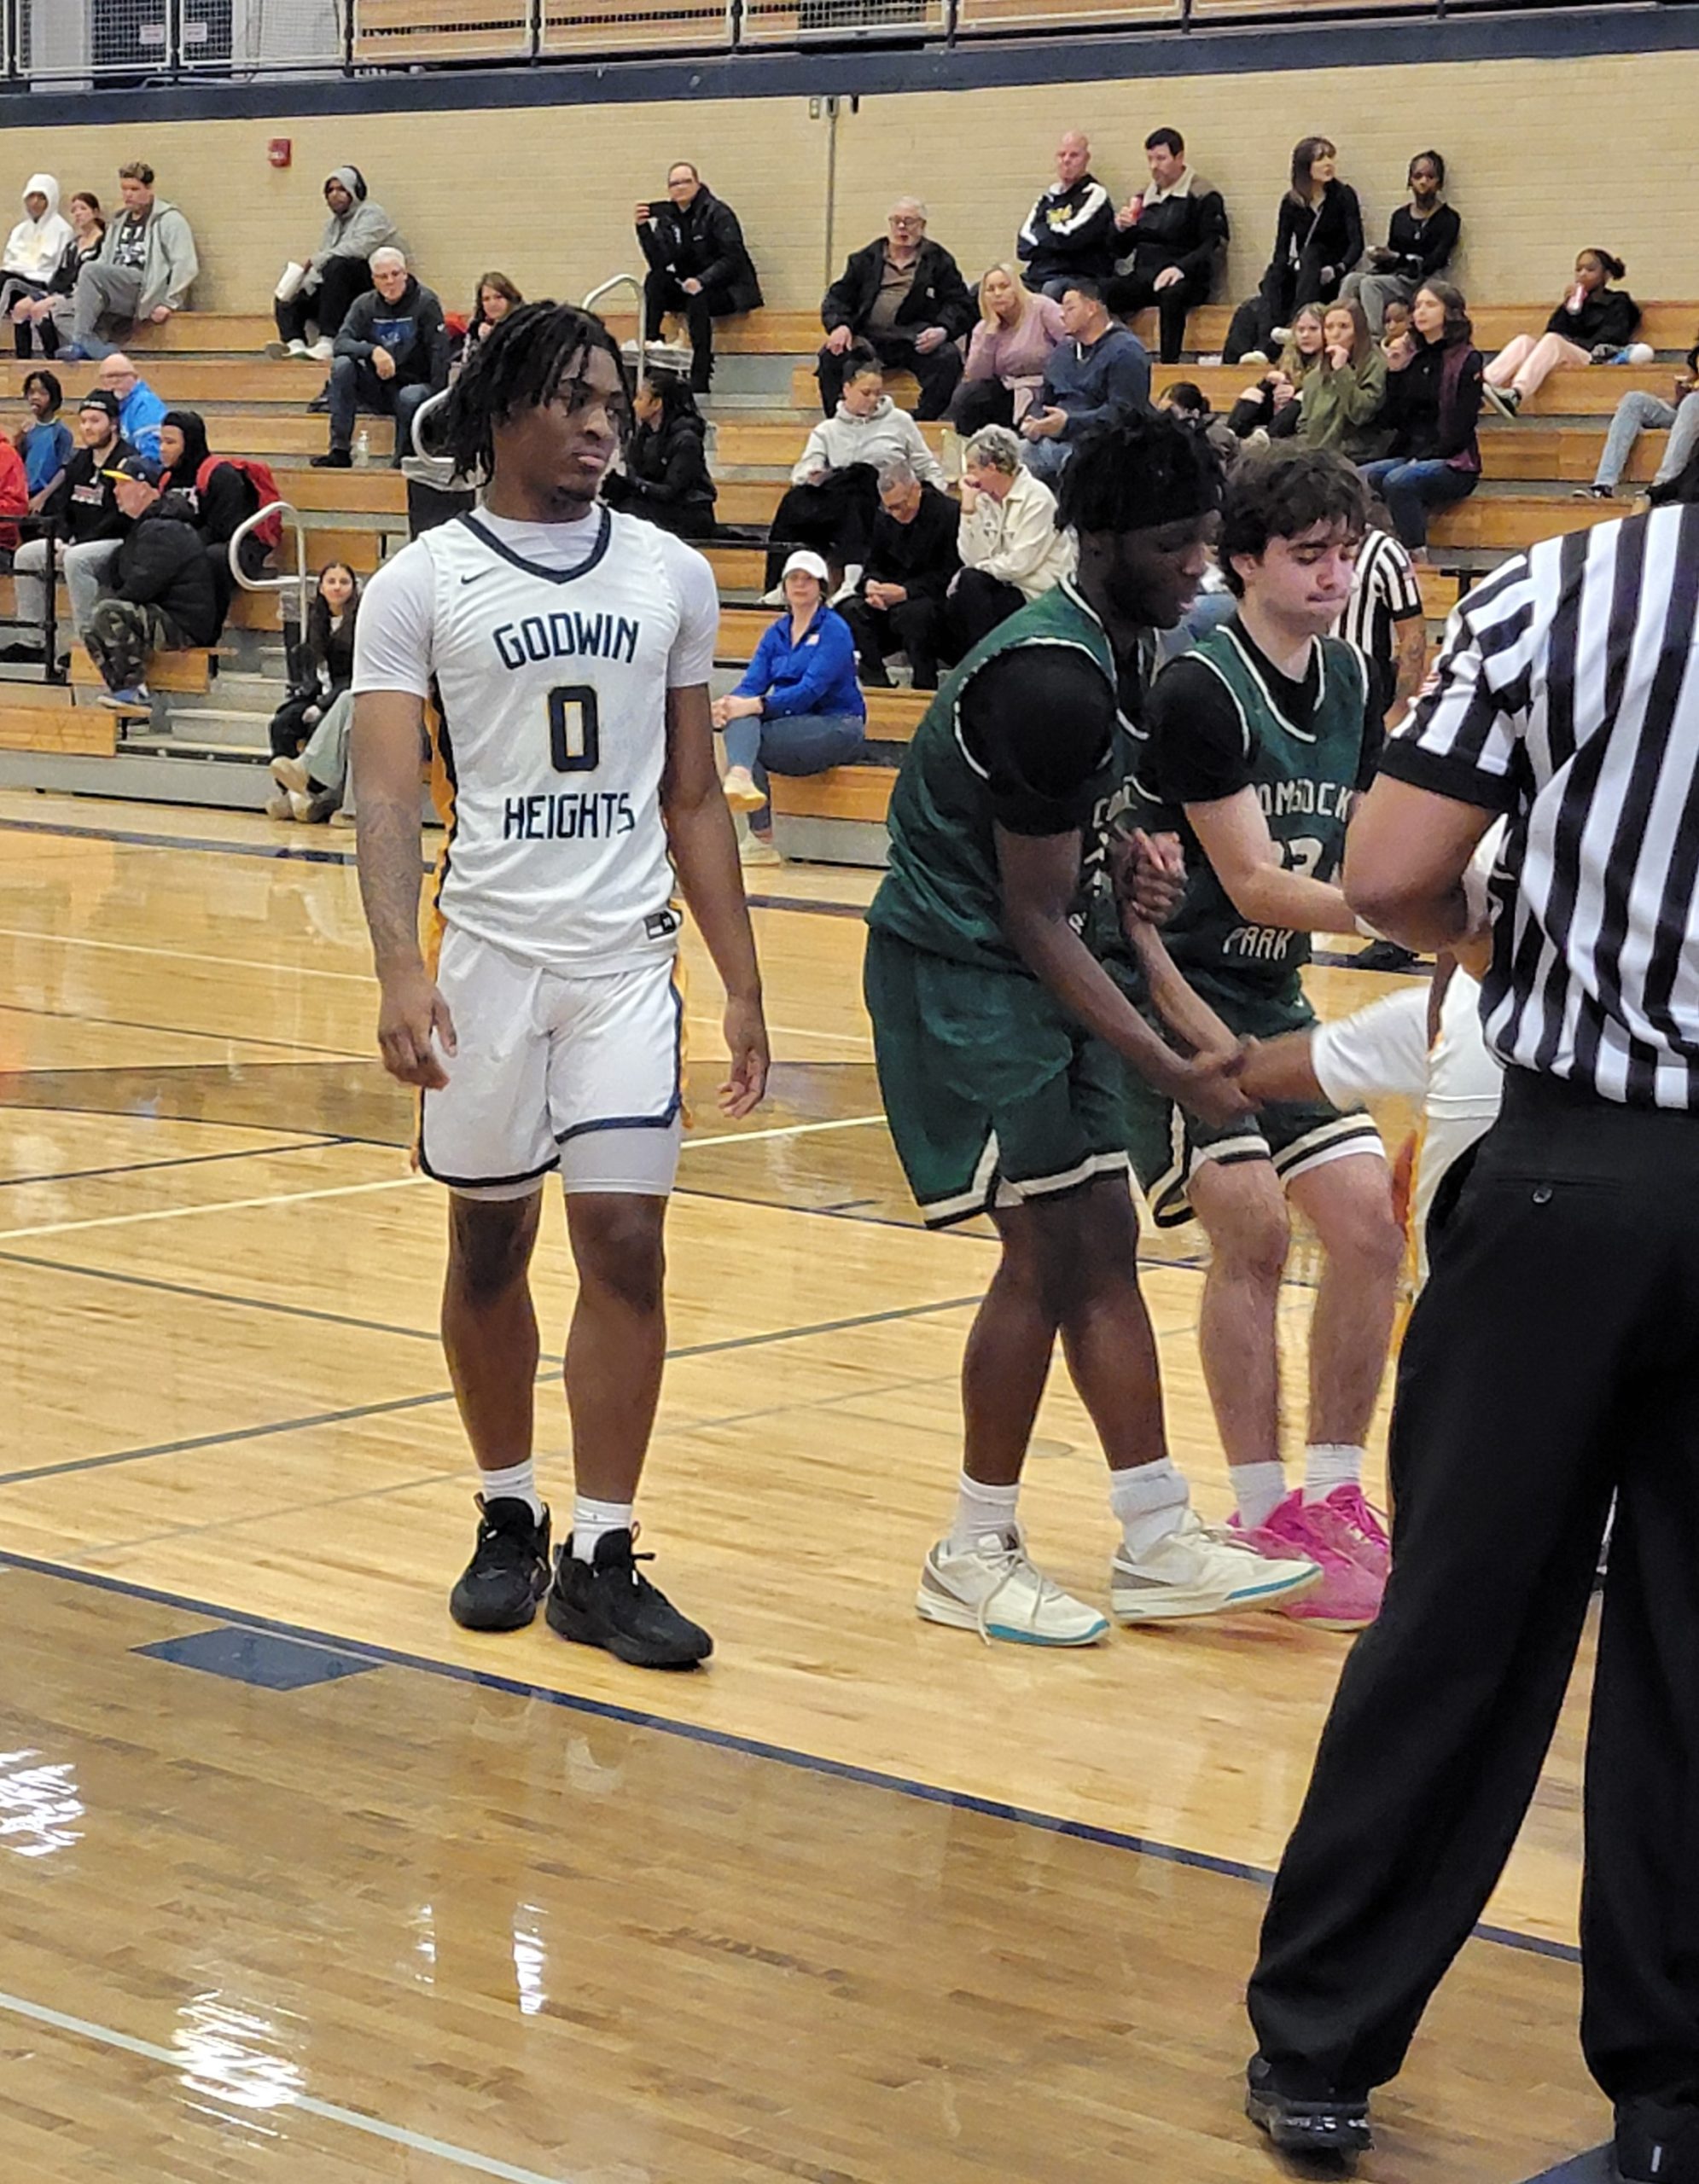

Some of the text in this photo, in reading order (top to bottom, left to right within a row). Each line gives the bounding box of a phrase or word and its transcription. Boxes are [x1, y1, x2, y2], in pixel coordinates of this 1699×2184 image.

[492, 611, 639, 671] GODWIN
[548, 685, 599, 773] 0
[503, 793, 635, 839] HEIGHTS
[1222, 925, 1295, 961] PARK
